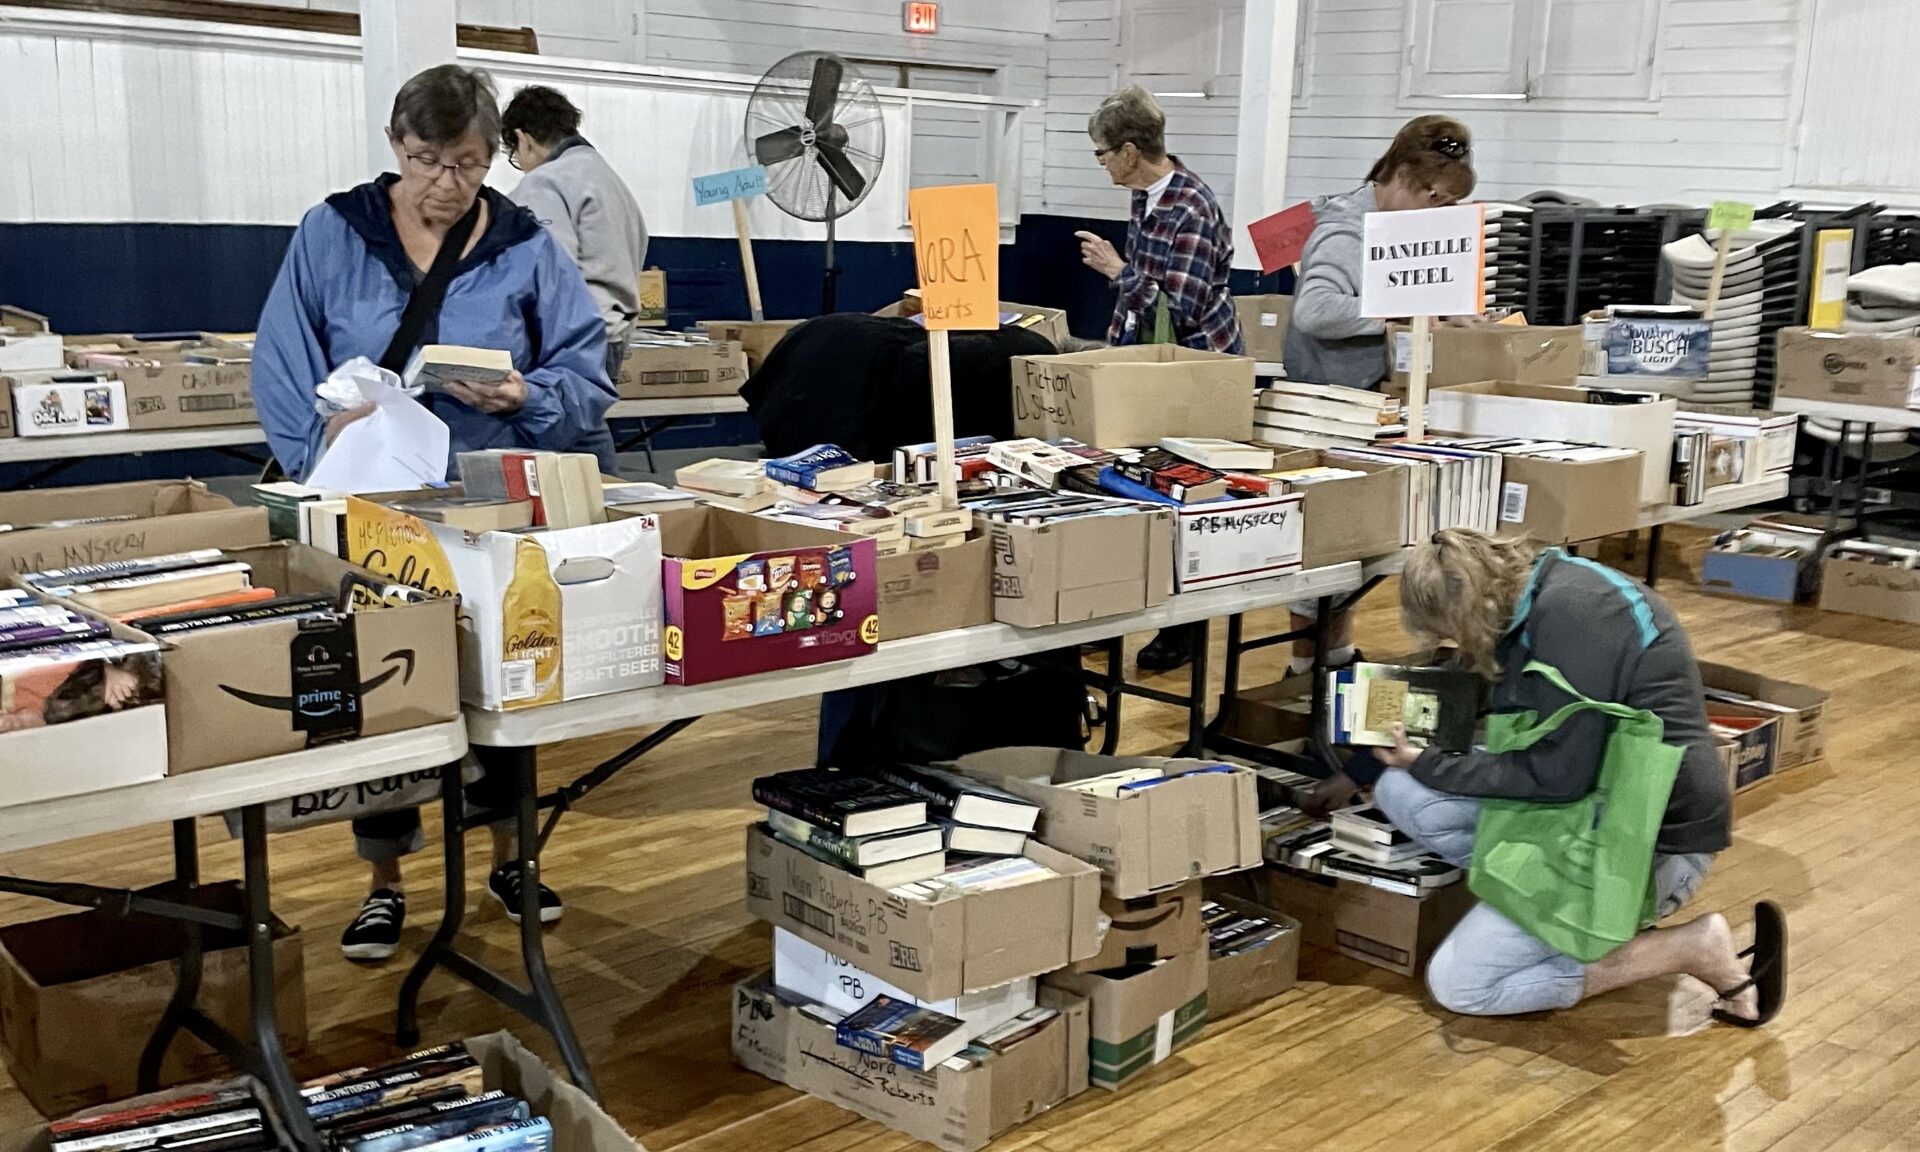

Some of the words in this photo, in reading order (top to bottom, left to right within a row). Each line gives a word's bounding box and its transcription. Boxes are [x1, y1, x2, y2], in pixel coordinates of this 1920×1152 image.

[694, 180, 729, 201] Young
[1369, 236, 1472, 261] DANIELLE
[1386, 266, 1454, 288] STEEL
[1632, 338, 1688, 356] BUSCH
[1642, 355, 1675, 363] LIGHT
[1025, 360, 1076, 400] Fiction
[1032, 393, 1075, 426] Steel
[640, 517, 656, 529] 24
[1224, 509, 1288, 535] MYSTERY
[64, 531, 146, 567] MYSTERY
[865, 619, 879, 635] 42
[506, 630, 560, 656] Golden
[668, 630, 680, 650] 42
[620, 658, 660, 678] BEER
[299, 689, 342, 708] prime
[818, 875, 862, 923] Roberts
[867, 898, 889, 935] PB
[840, 975, 865, 999] PB
[858, 1052, 897, 1078] Nora
[875, 1077, 937, 1107] Roberts
